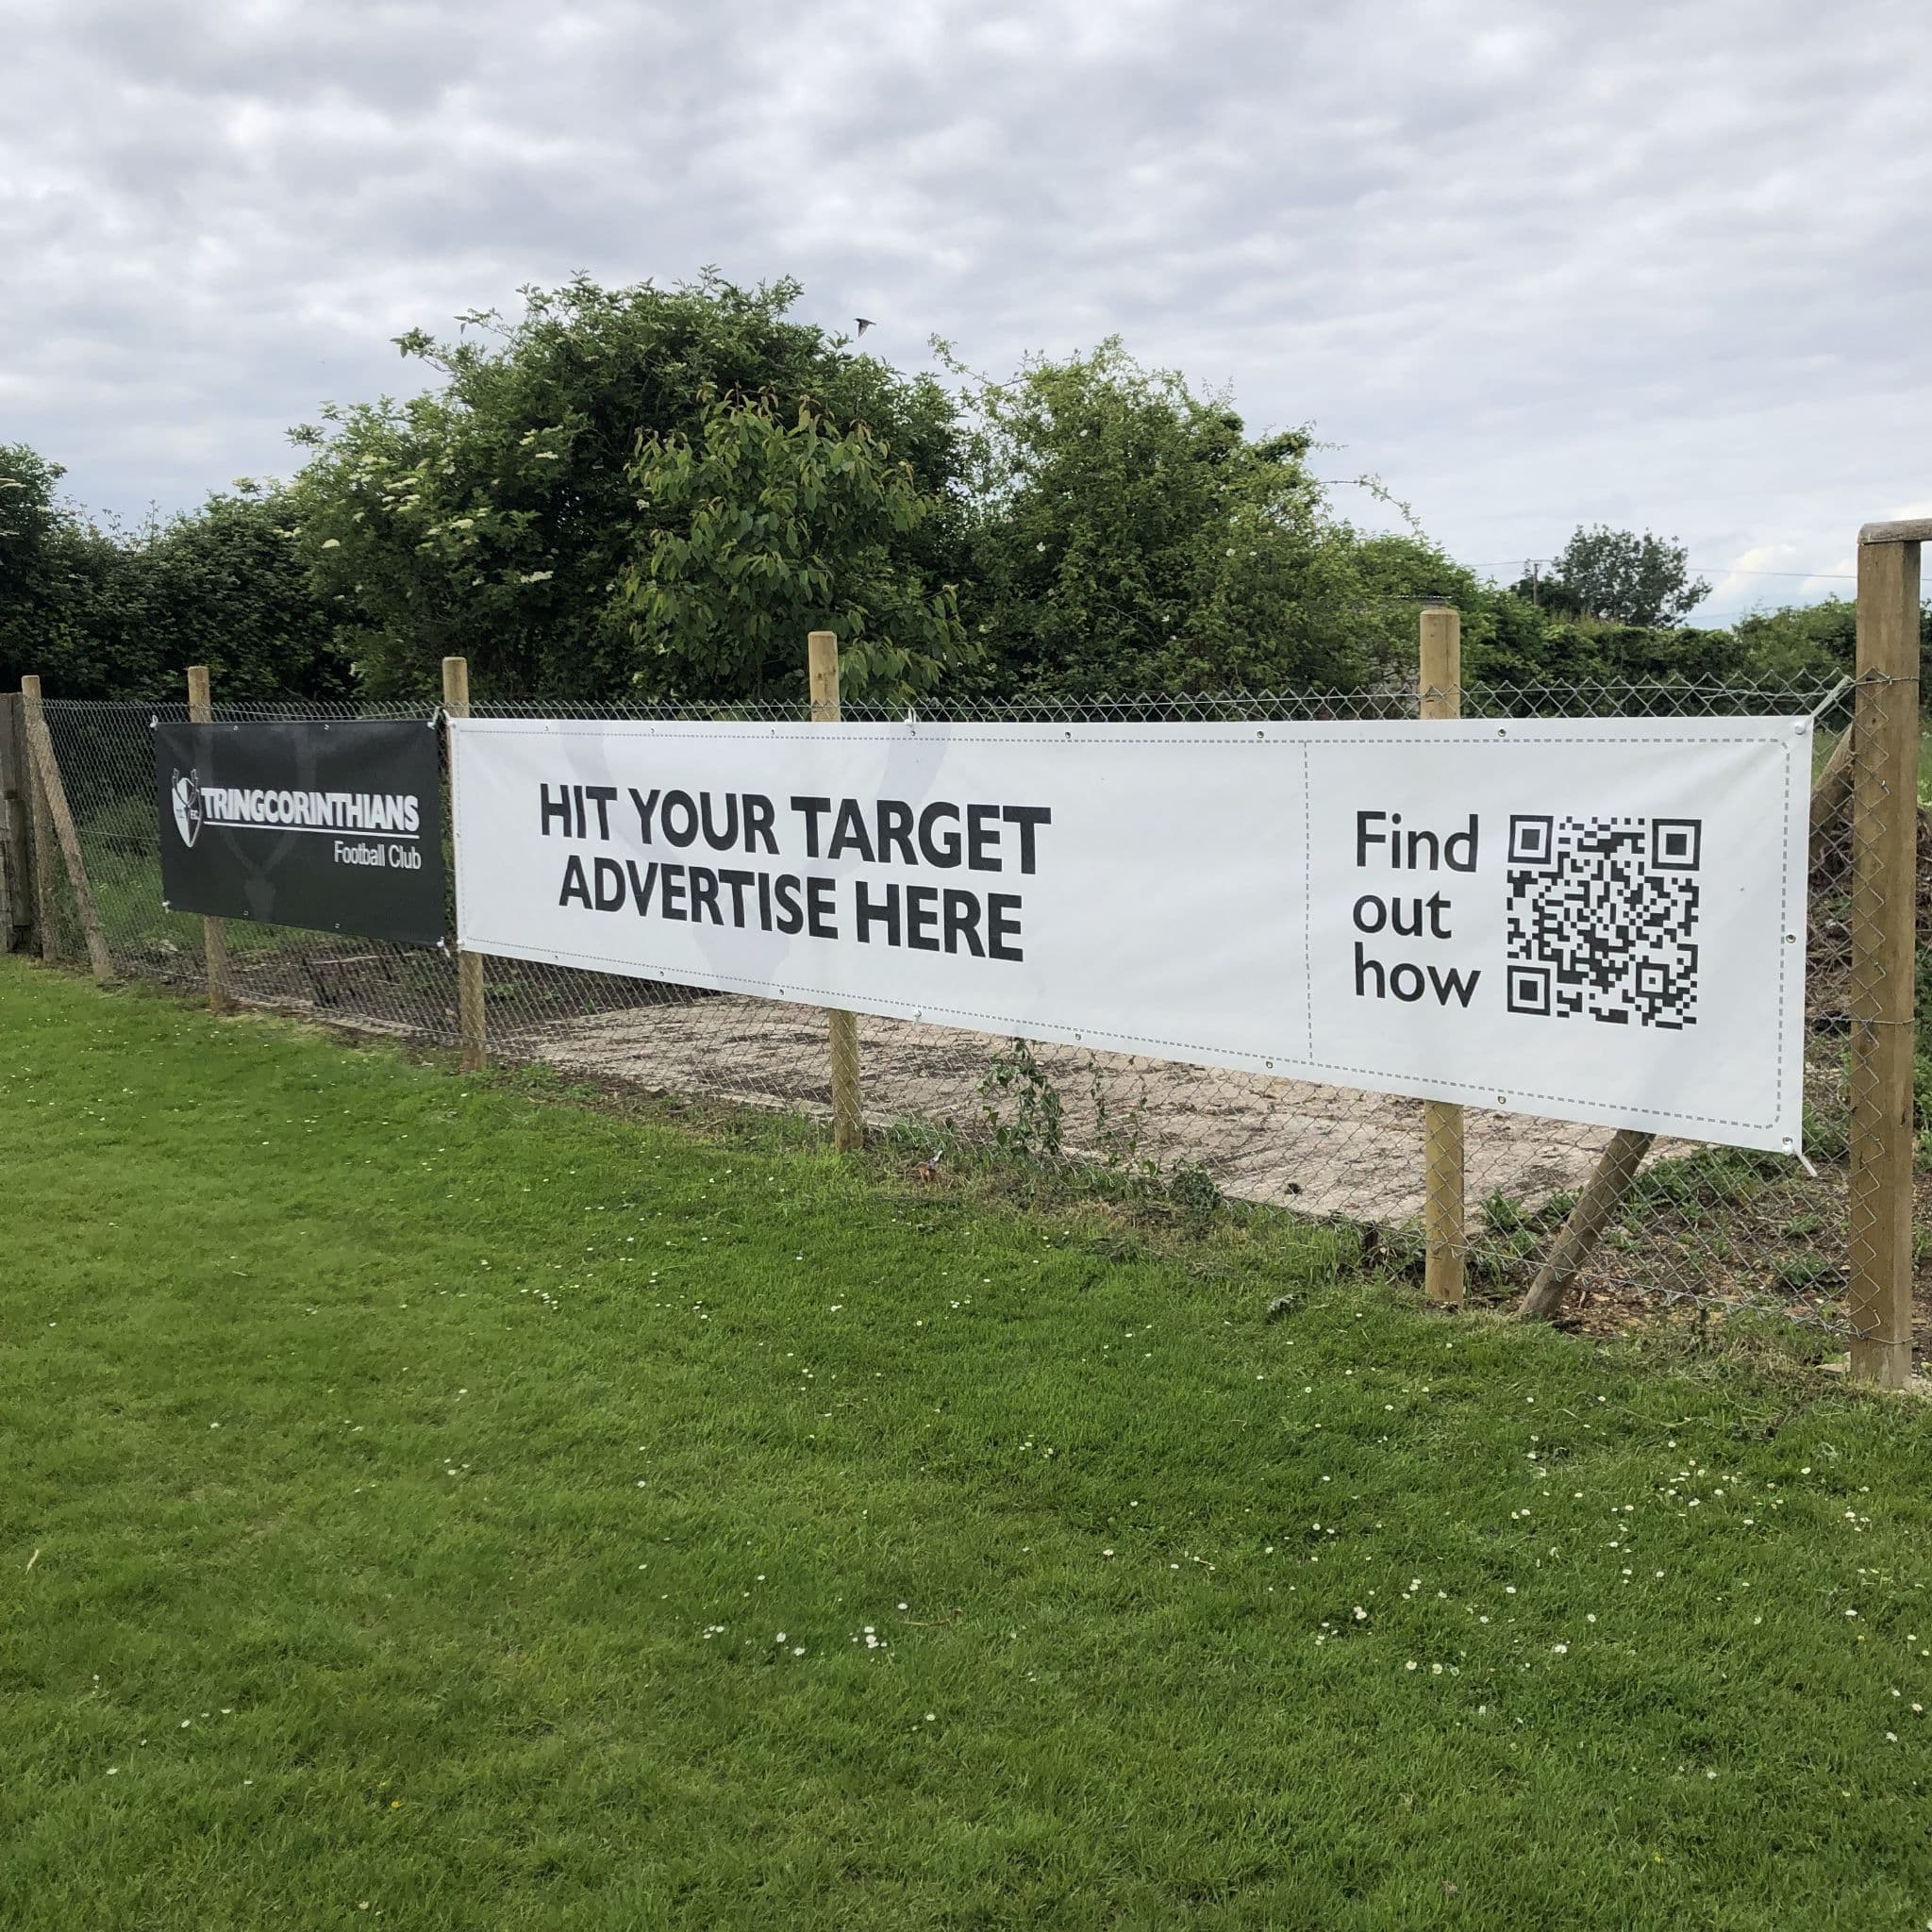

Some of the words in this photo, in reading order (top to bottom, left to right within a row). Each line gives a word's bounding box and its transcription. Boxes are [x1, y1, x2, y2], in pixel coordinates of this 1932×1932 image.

[334, 841, 386, 867] Football
[388, 844, 422, 870] Club
[541, 783, 618, 841] HIT
[628, 789, 780, 855] YOUR
[791, 796, 1052, 874] TARGET
[1357, 810, 1479, 873] Find
[558, 856, 839, 939] ADVERTISE
[856, 881, 1024, 962] HERE
[1353, 891, 1452, 940] out
[1355, 941, 1482, 1008] how
